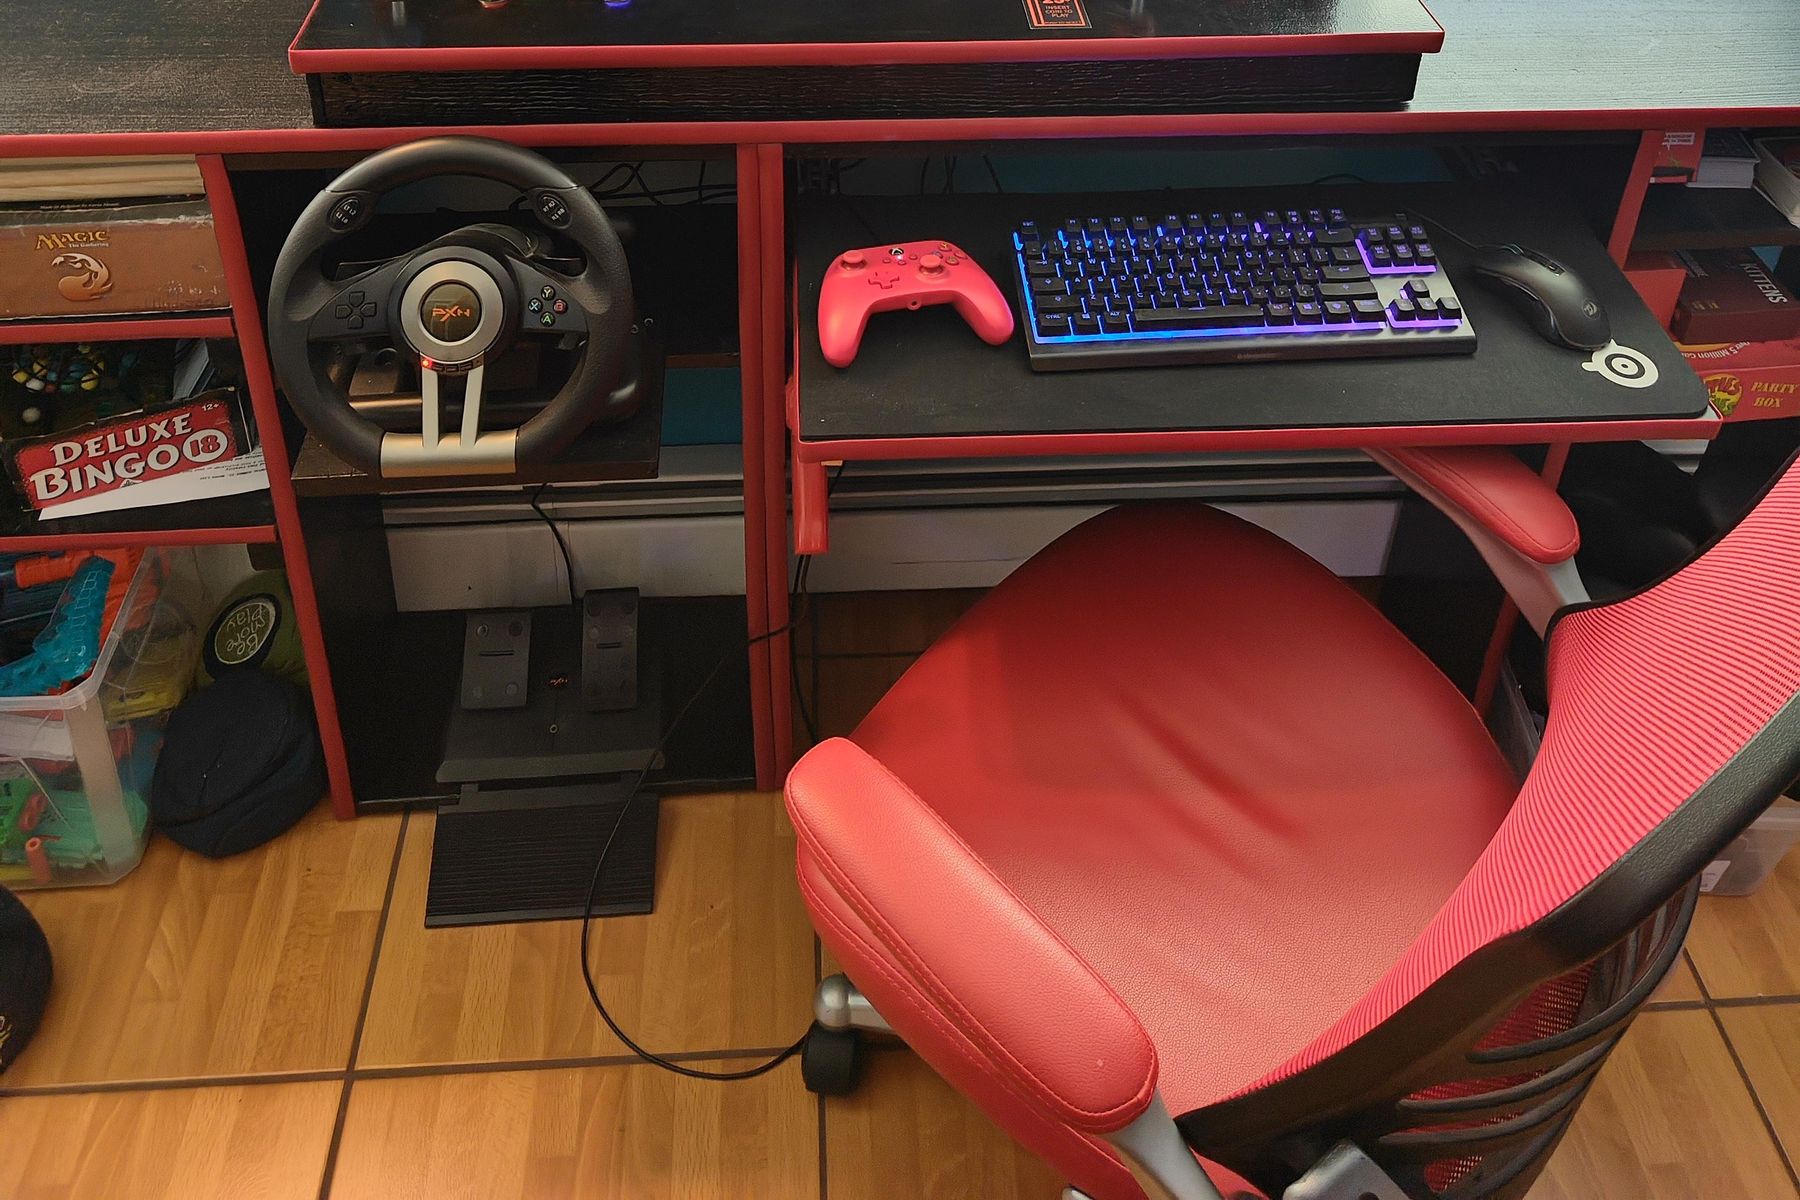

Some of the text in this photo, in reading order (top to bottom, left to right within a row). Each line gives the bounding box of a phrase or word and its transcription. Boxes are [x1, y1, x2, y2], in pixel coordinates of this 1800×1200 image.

[34, 230, 110, 251] MAGIC
[1739, 262, 1788, 304] KITTENS
[431, 304, 471, 322] PXN
[1750, 381, 1799, 394] PARTY
[1753, 396, 1784, 407] BOX
[50, 412, 193, 467] DELUXE
[30, 444, 180, 501] BINGO
[190, 432, 222, 457] 18
